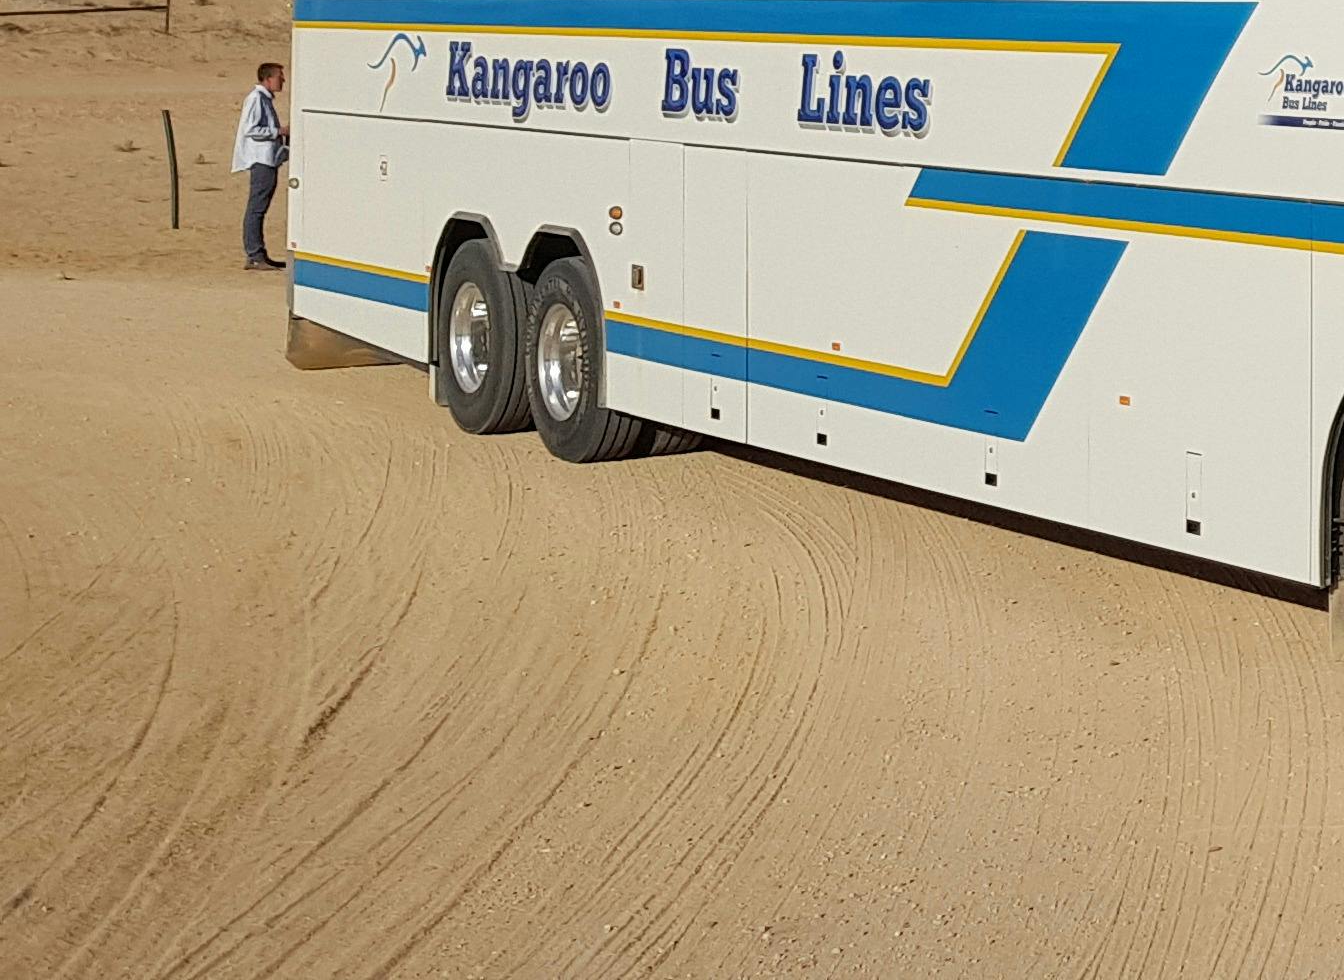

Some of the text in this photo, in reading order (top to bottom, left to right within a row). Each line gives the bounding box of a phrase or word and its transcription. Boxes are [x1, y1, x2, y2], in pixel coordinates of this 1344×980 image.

[446, 41, 930, 133] Kangaroo Bus Lines
[1282, 96, 1327, 111] Bus Lines
